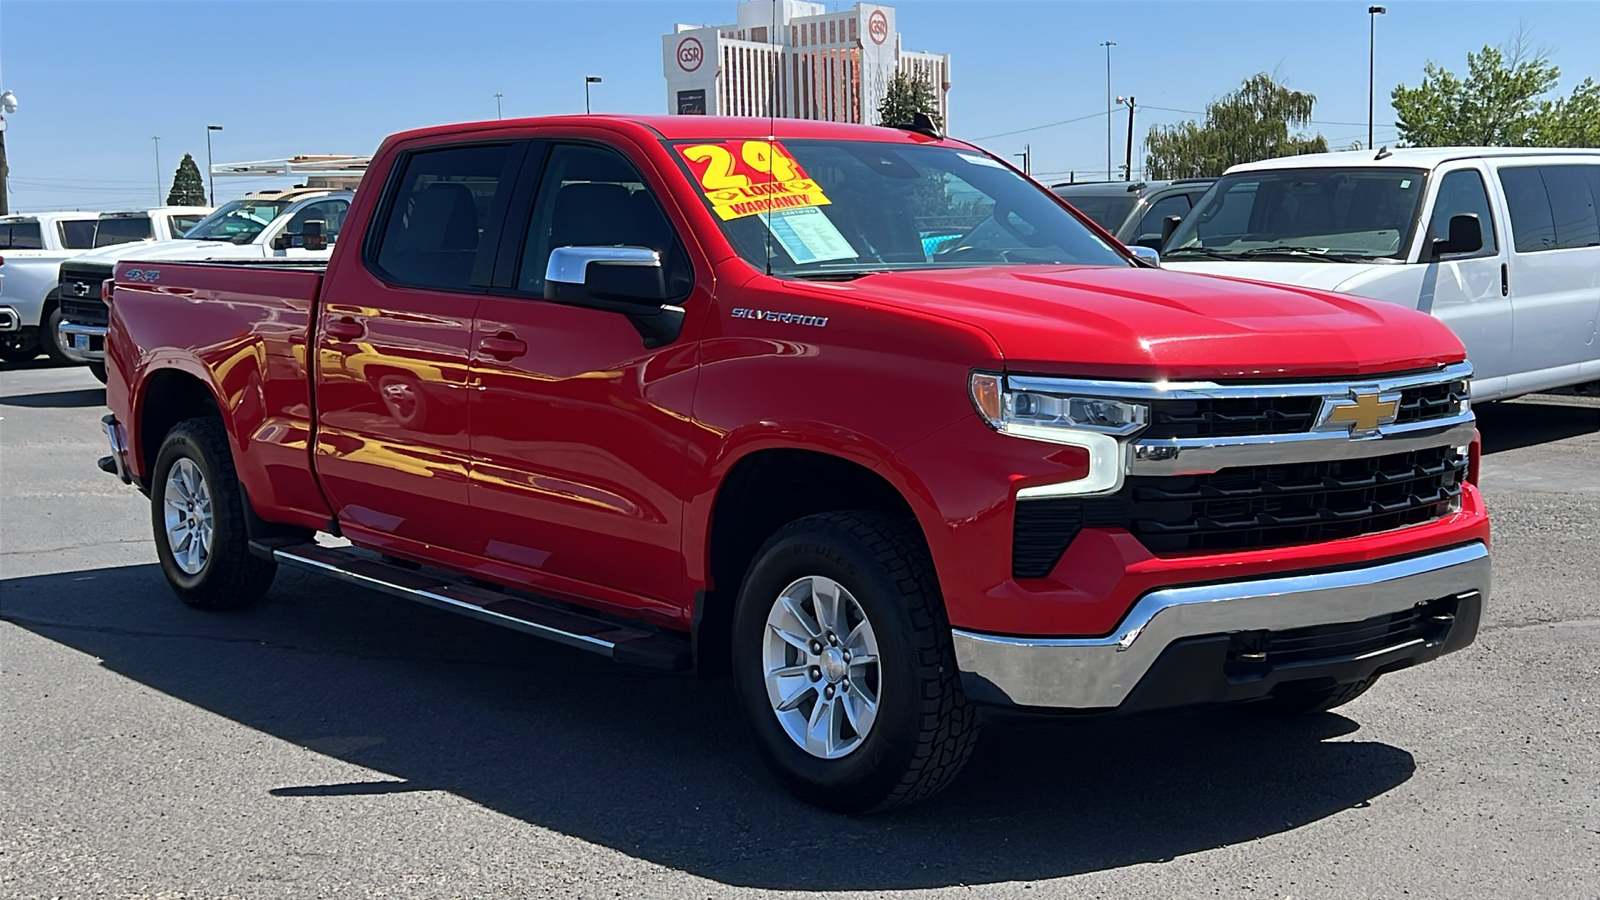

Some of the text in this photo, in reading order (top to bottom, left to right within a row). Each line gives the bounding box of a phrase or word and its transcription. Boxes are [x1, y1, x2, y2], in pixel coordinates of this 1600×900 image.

[870, 19, 886, 36] GSR
[680, 46, 700, 62] GSR
[682, 140, 803, 190] 24
[738, 182, 791, 198] LOOK
[729, 193, 812, 216] WARRANTY
[731, 307, 829, 328] SILVERADO
